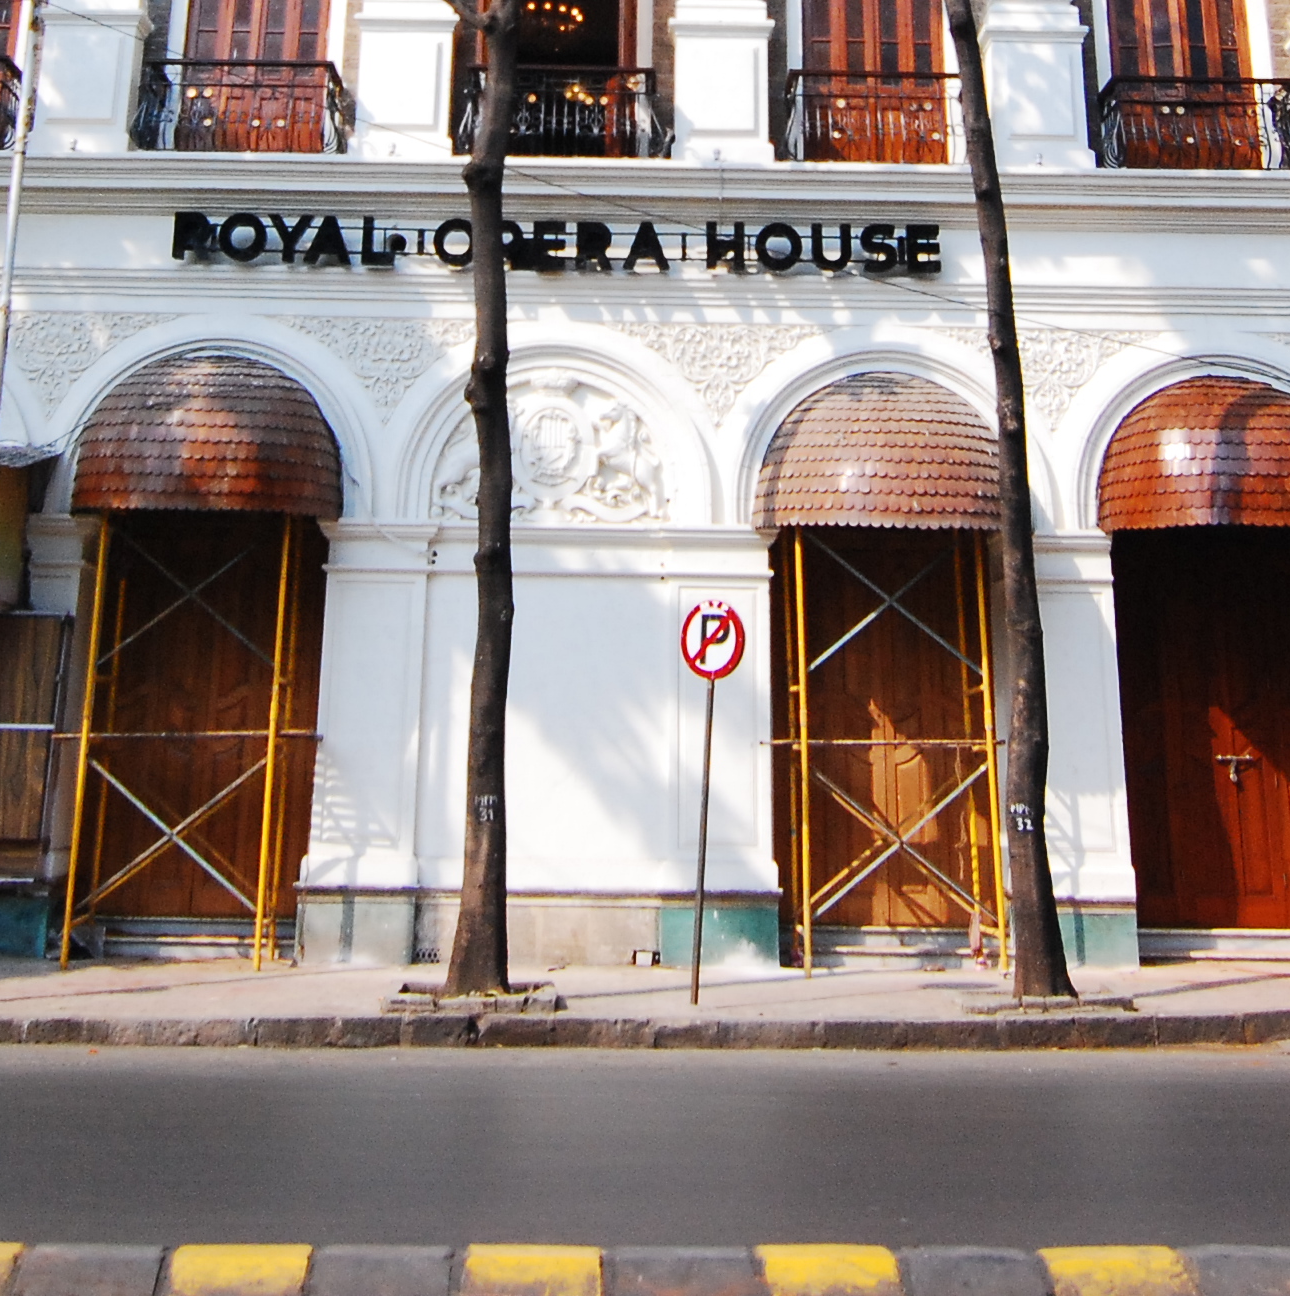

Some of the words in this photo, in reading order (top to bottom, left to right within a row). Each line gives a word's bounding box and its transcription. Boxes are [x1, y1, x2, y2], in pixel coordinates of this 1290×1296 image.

[172, 211, 395, 266] ROYAL
[706, 221, 941, 273] HOUSE
[479, 807, 494, 821] 31
[1016, 817, 1034, 831] 32
